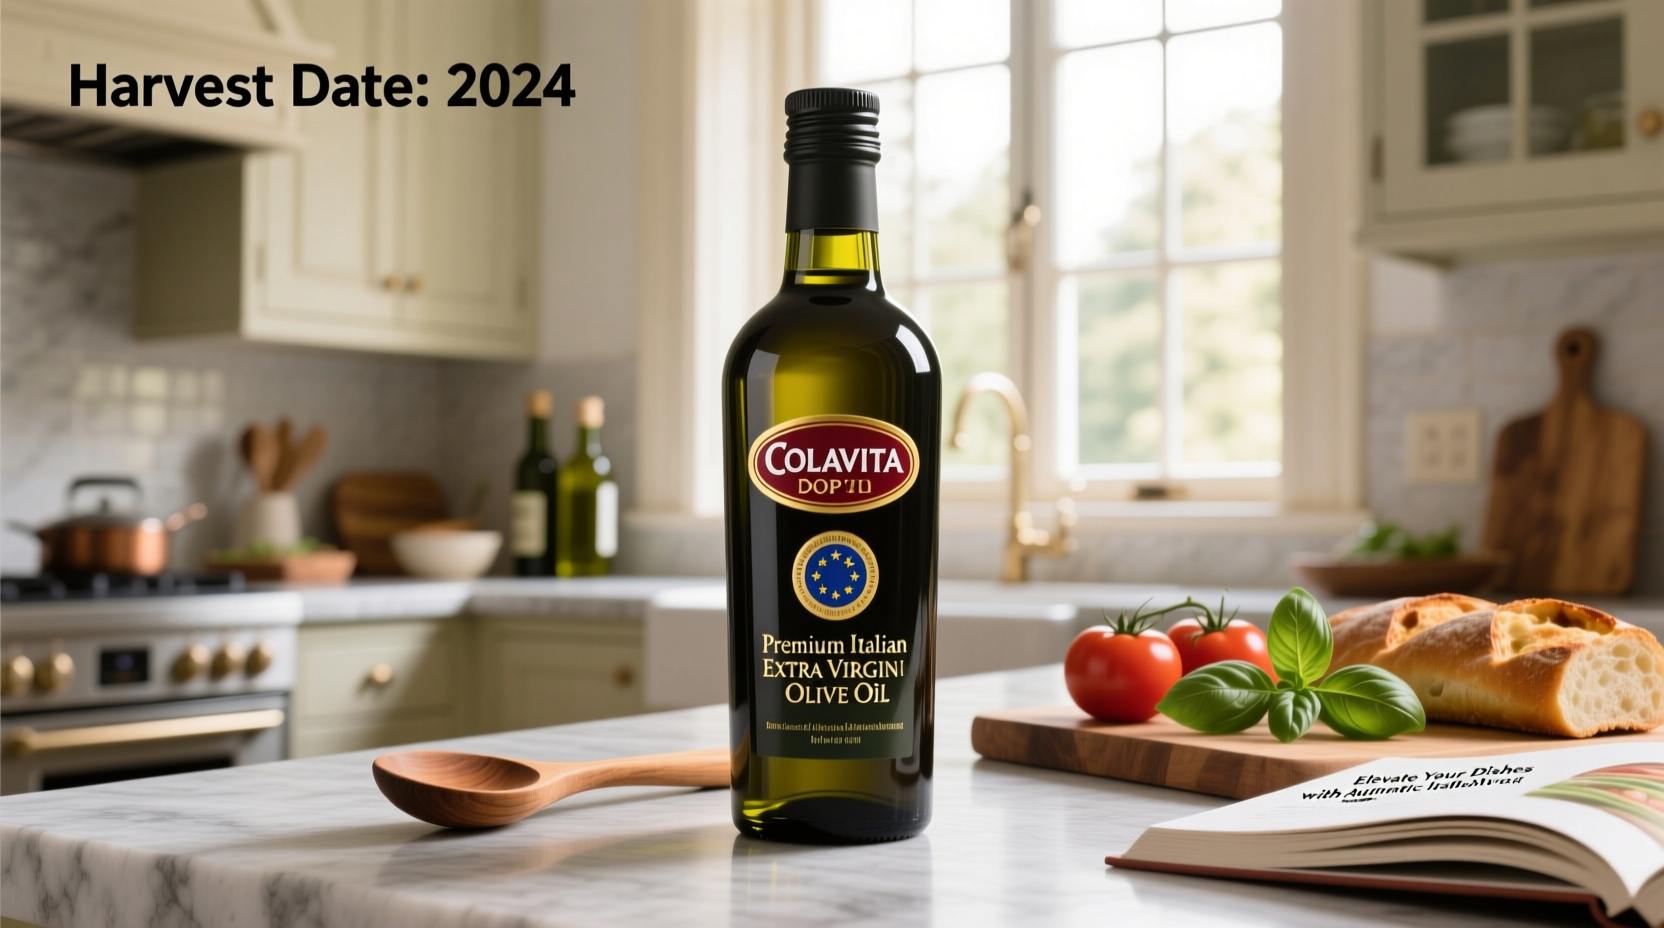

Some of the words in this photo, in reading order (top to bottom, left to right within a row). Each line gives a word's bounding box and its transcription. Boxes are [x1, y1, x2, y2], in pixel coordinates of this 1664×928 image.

[764, 441, 904, 476] COLAVITA
[762, 633, 845, 654] Premium
[851, 634, 907, 654] Italian
[762, 658, 823, 679] EXTRA
[785, 682, 849, 704] OLIVE
[1425, 770, 1467, 781] Your
[1302, 788, 1342, 800] with
